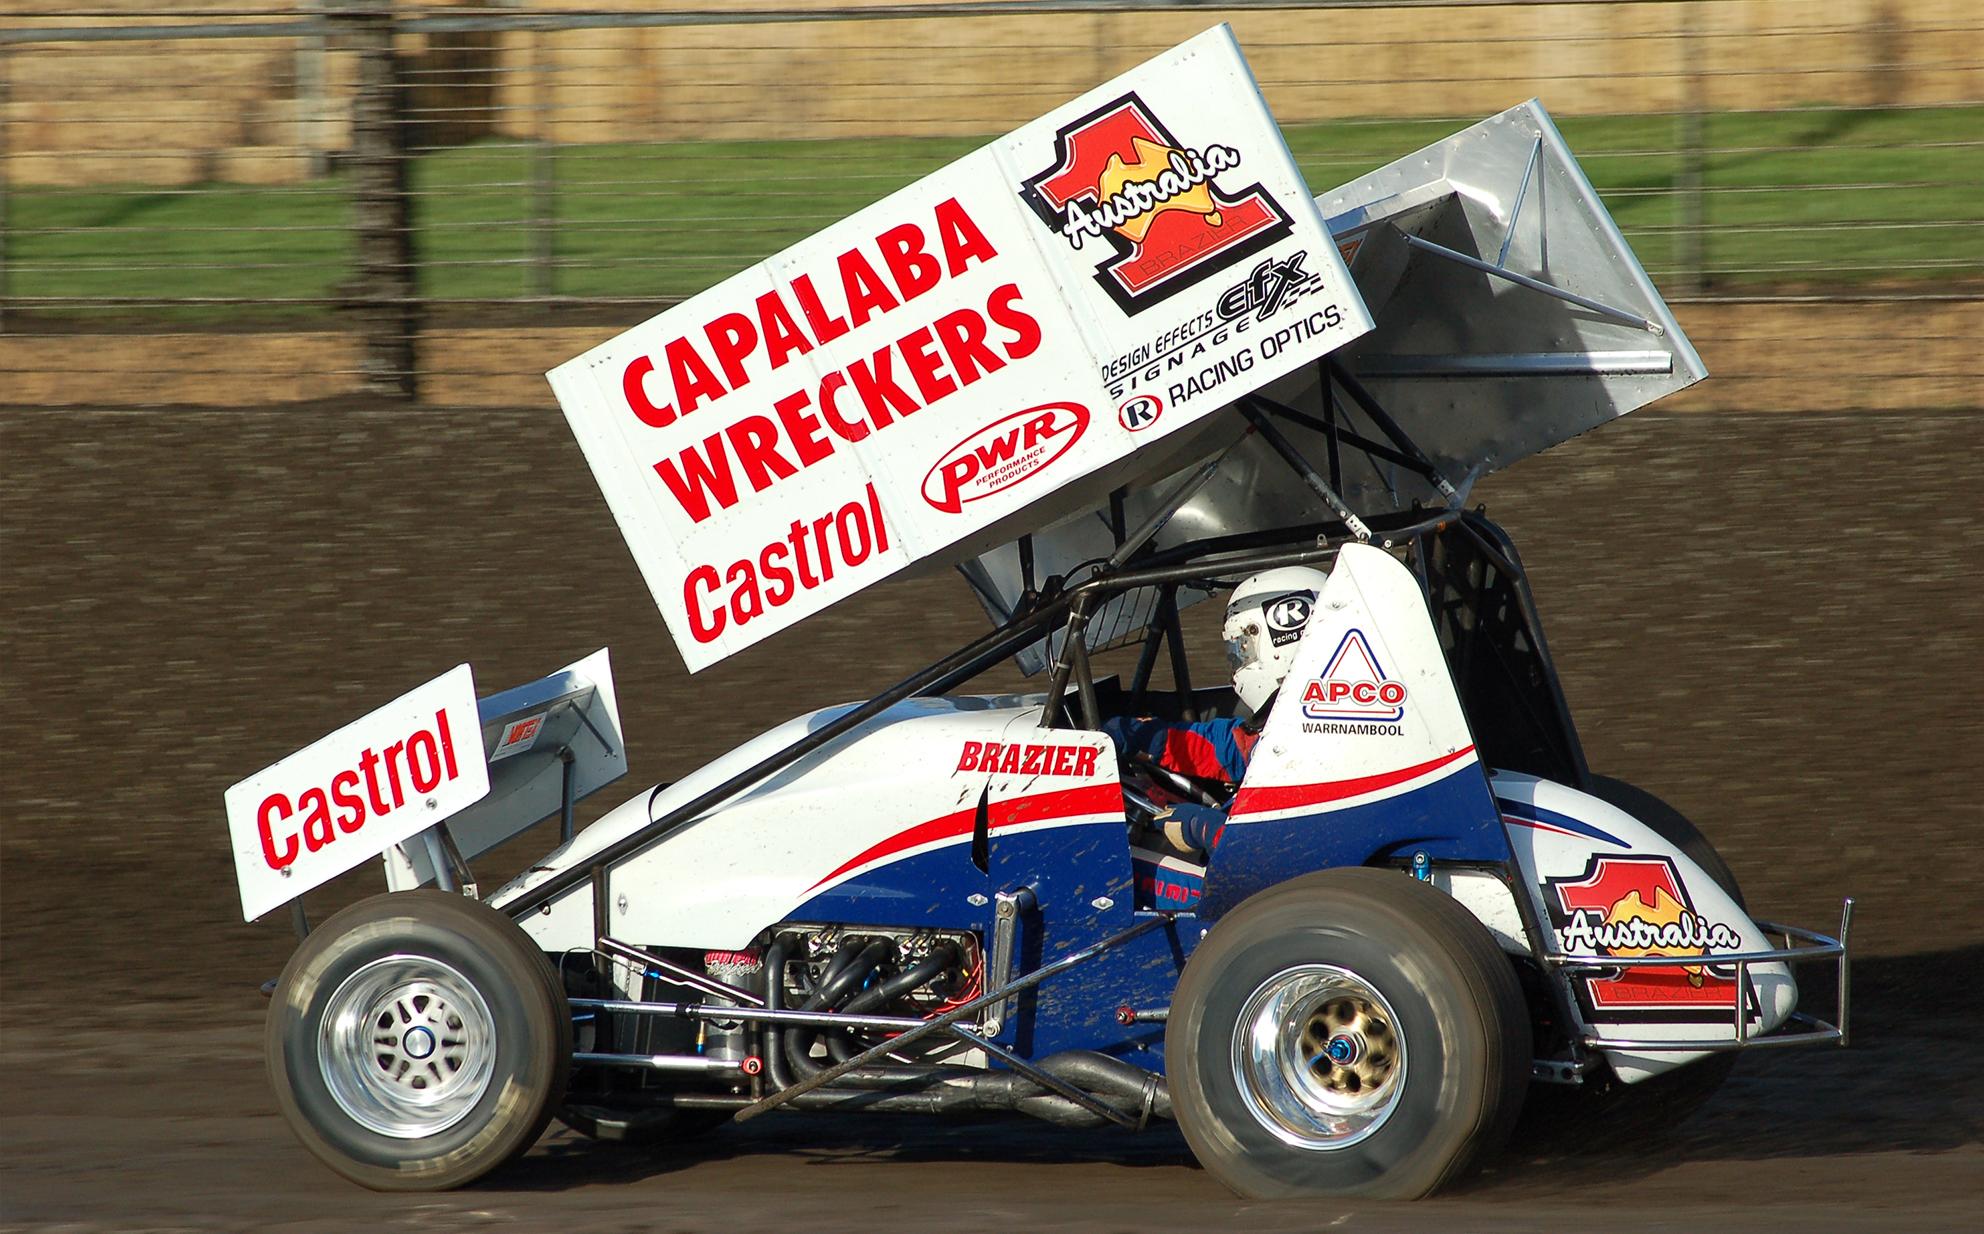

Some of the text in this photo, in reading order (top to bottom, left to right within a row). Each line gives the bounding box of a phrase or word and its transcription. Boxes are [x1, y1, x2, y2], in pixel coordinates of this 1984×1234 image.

[1063, 144, 1240, 250] Australia
[1140, 216, 1248, 275] BRAZIER
[623, 197, 998, 428] CAPALABA
[1101, 309, 1213, 382] DESIGN EFFECTS
[1109, 317, 1250, 400] SIGNAGE
[1168, 348, 1254, 408] RACING
[1260, 304, 1341, 360] OPTICS
[653, 283, 1042, 524] WRECKERS
[940, 411, 1057, 513] PWR
[975, 446, 1046, 487] PERFORMANCE
[988, 458, 1040, 488] PRODUCTS
[683, 482, 889, 643] Castrol
[1272, 631, 1298, 644] racing
[1302, 680, 1406, 706] APCO
[1302, 722, 1405, 737] WARRNAMBOOL
[257, 708, 459, 871] Castrol
[957, 741, 1098, 777] BRAZIER
[1563, 909, 1741, 950] Australia
